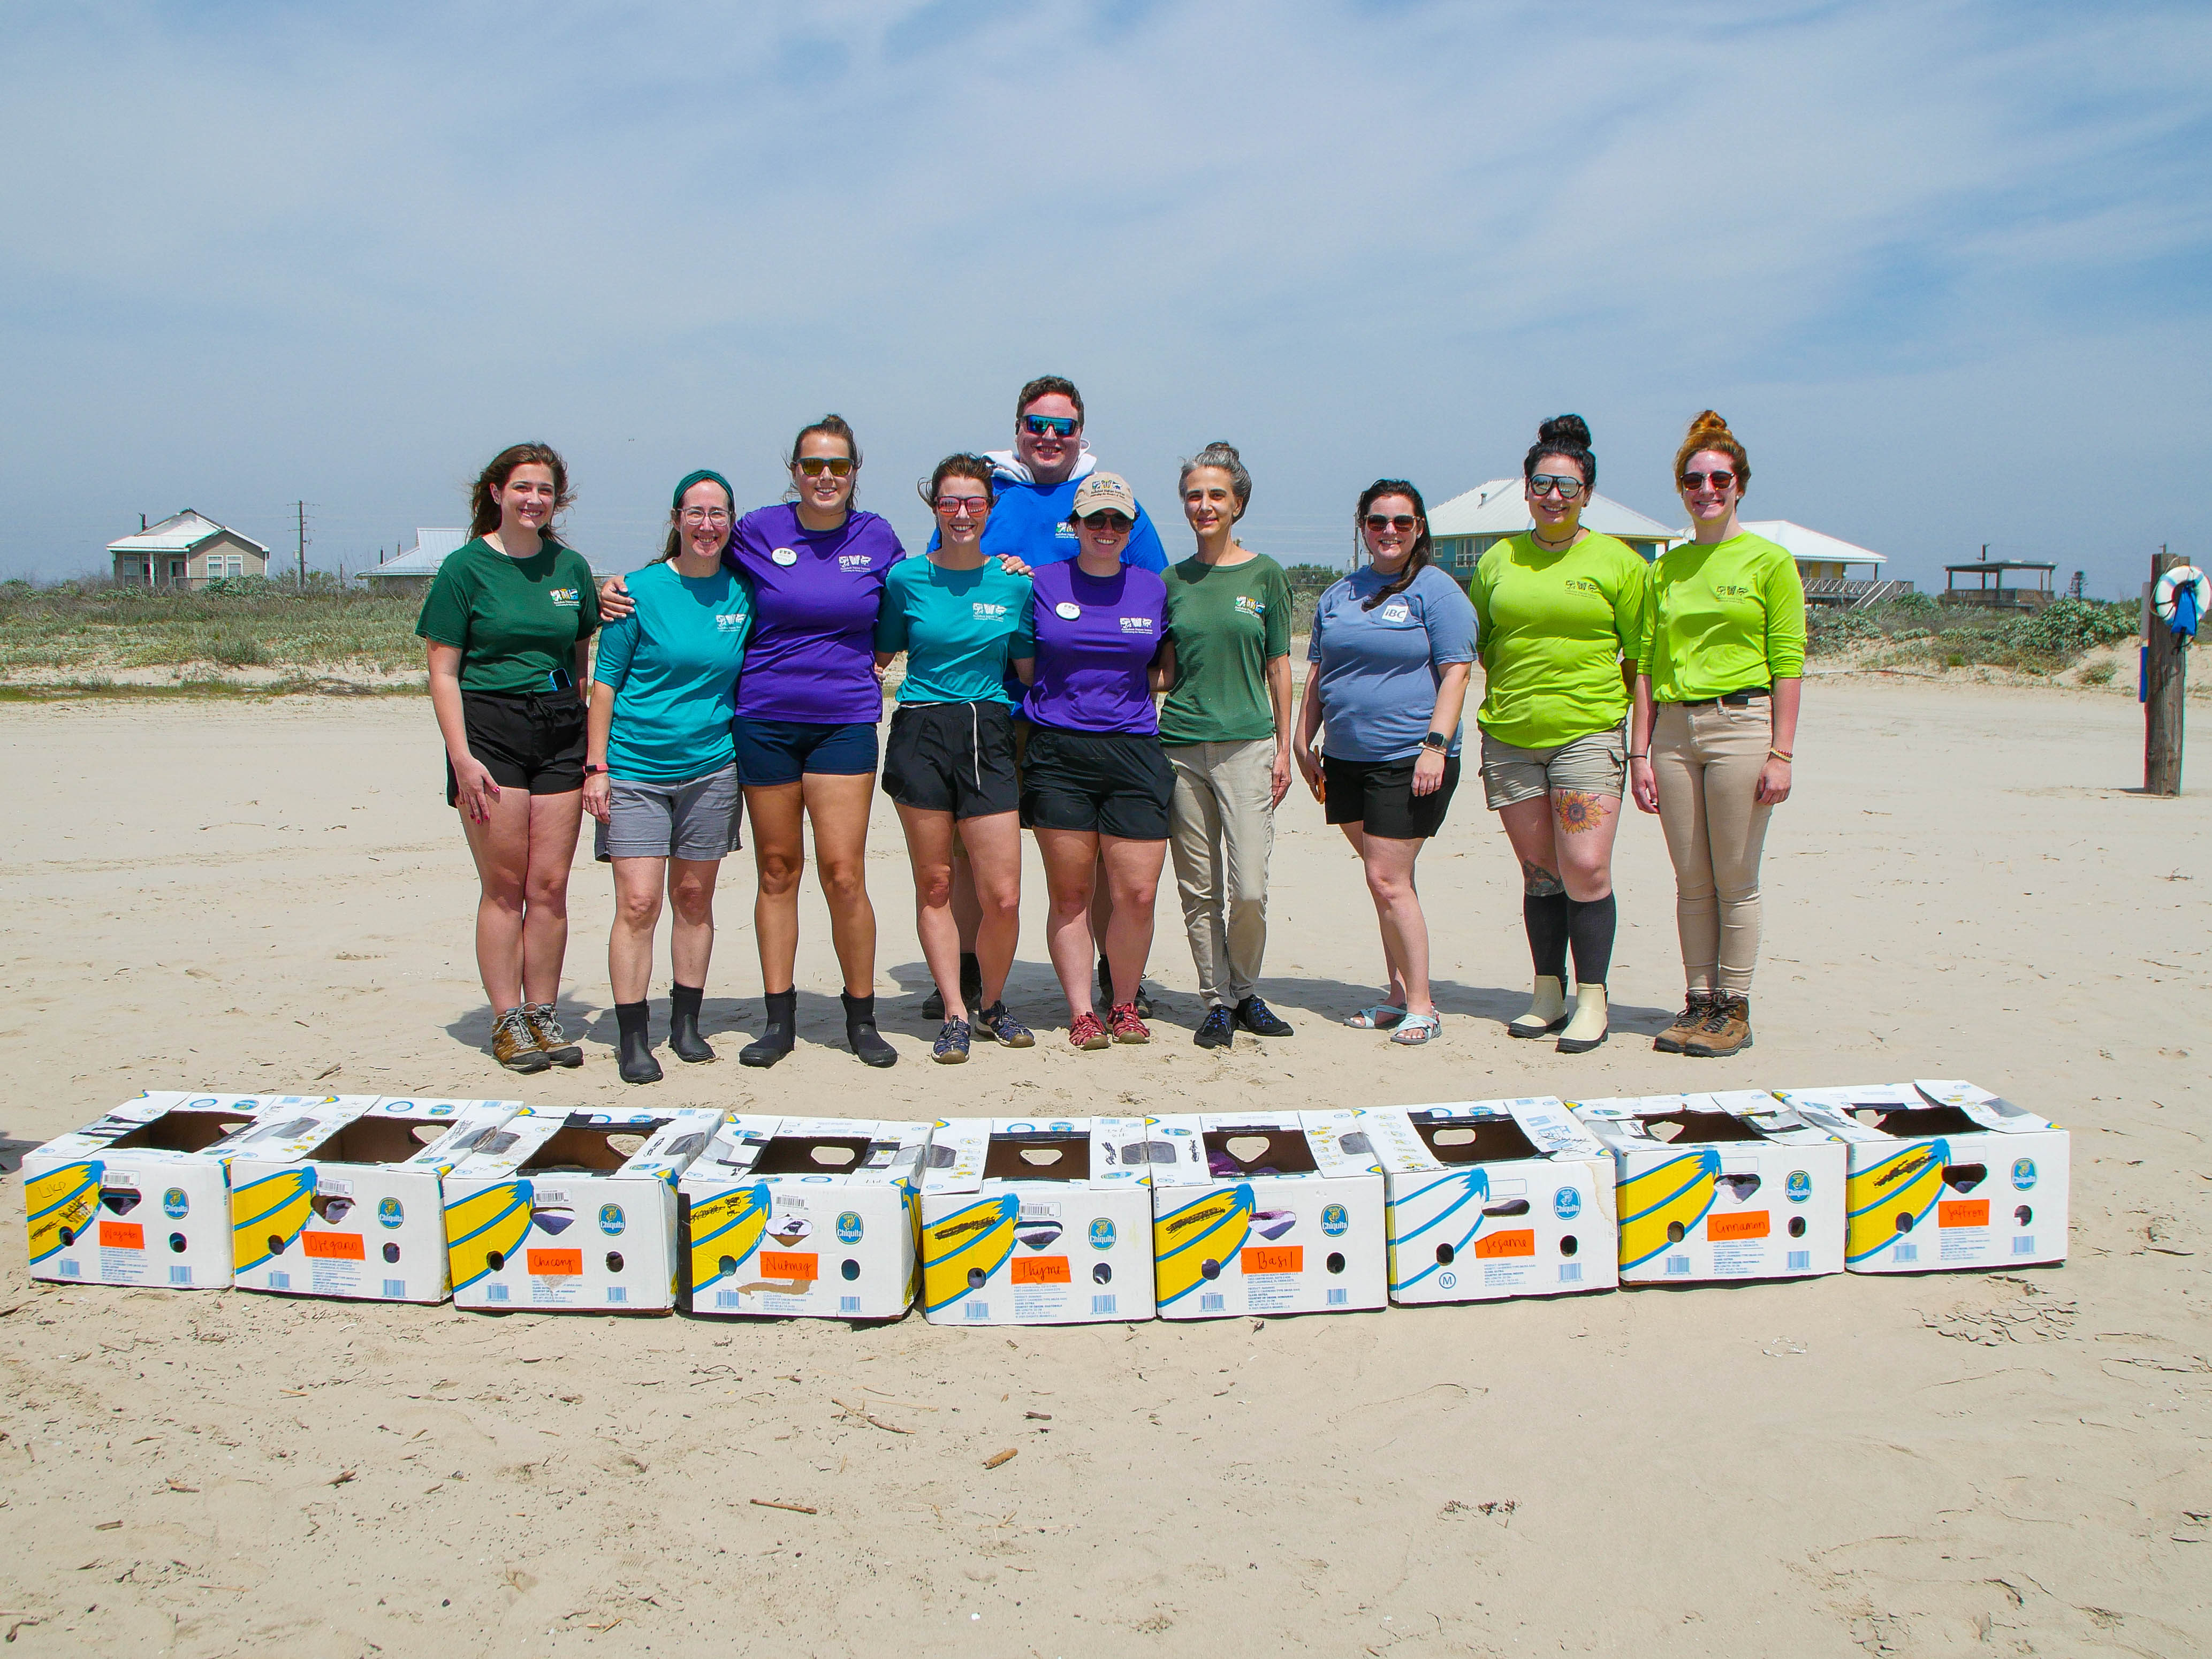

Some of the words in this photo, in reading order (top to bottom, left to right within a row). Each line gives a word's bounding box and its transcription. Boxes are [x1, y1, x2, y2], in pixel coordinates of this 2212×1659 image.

[1385, 609, 1405, 619] iBC
[1555, 1204, 1579, 1214] Chiquita
[379, 1213, 404, 1223] Chiquita
[600, 1220, 624, 1230] Chiquita
[1322, 1221, 1347, 1231] Chiquita
[1715, 1220, 1765, 1234] Cinnamon
[837, 1229, 863, 1238] Chiquita
[1089, 1234, 1115, 1244] Chiquita
[310, 1235, 357, 1257] Oregano
[1485, 1237, 1527, 1253] Sesame
[1257, 1251, 1293, 1270] Basil
[766, 1257, 812, 1277] Nutmeg
[1018, 1260, 1060, 1281] Thyme
[1443, 1276, 1452, 1285] M
